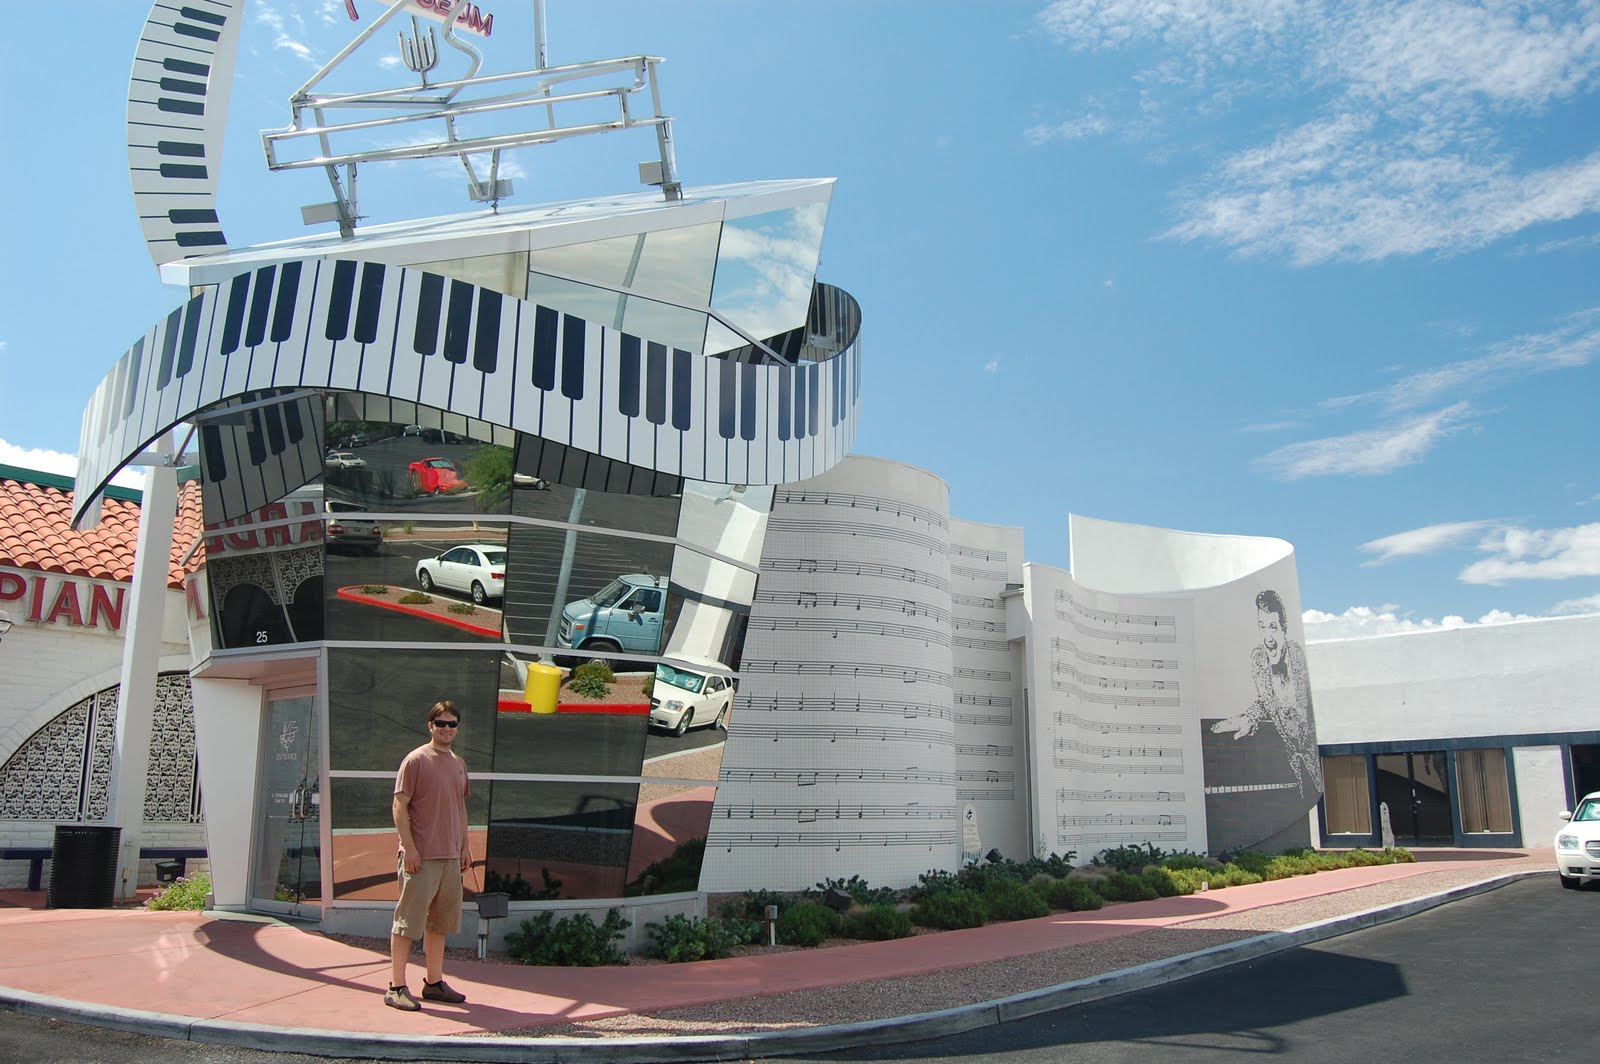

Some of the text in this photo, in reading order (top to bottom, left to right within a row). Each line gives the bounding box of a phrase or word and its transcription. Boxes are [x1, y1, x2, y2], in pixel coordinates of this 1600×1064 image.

[0, 572, 128, 631] PIAN
[256, 630, 268, 643] 25
[276, 752, 298, 761] ENTRANCE
